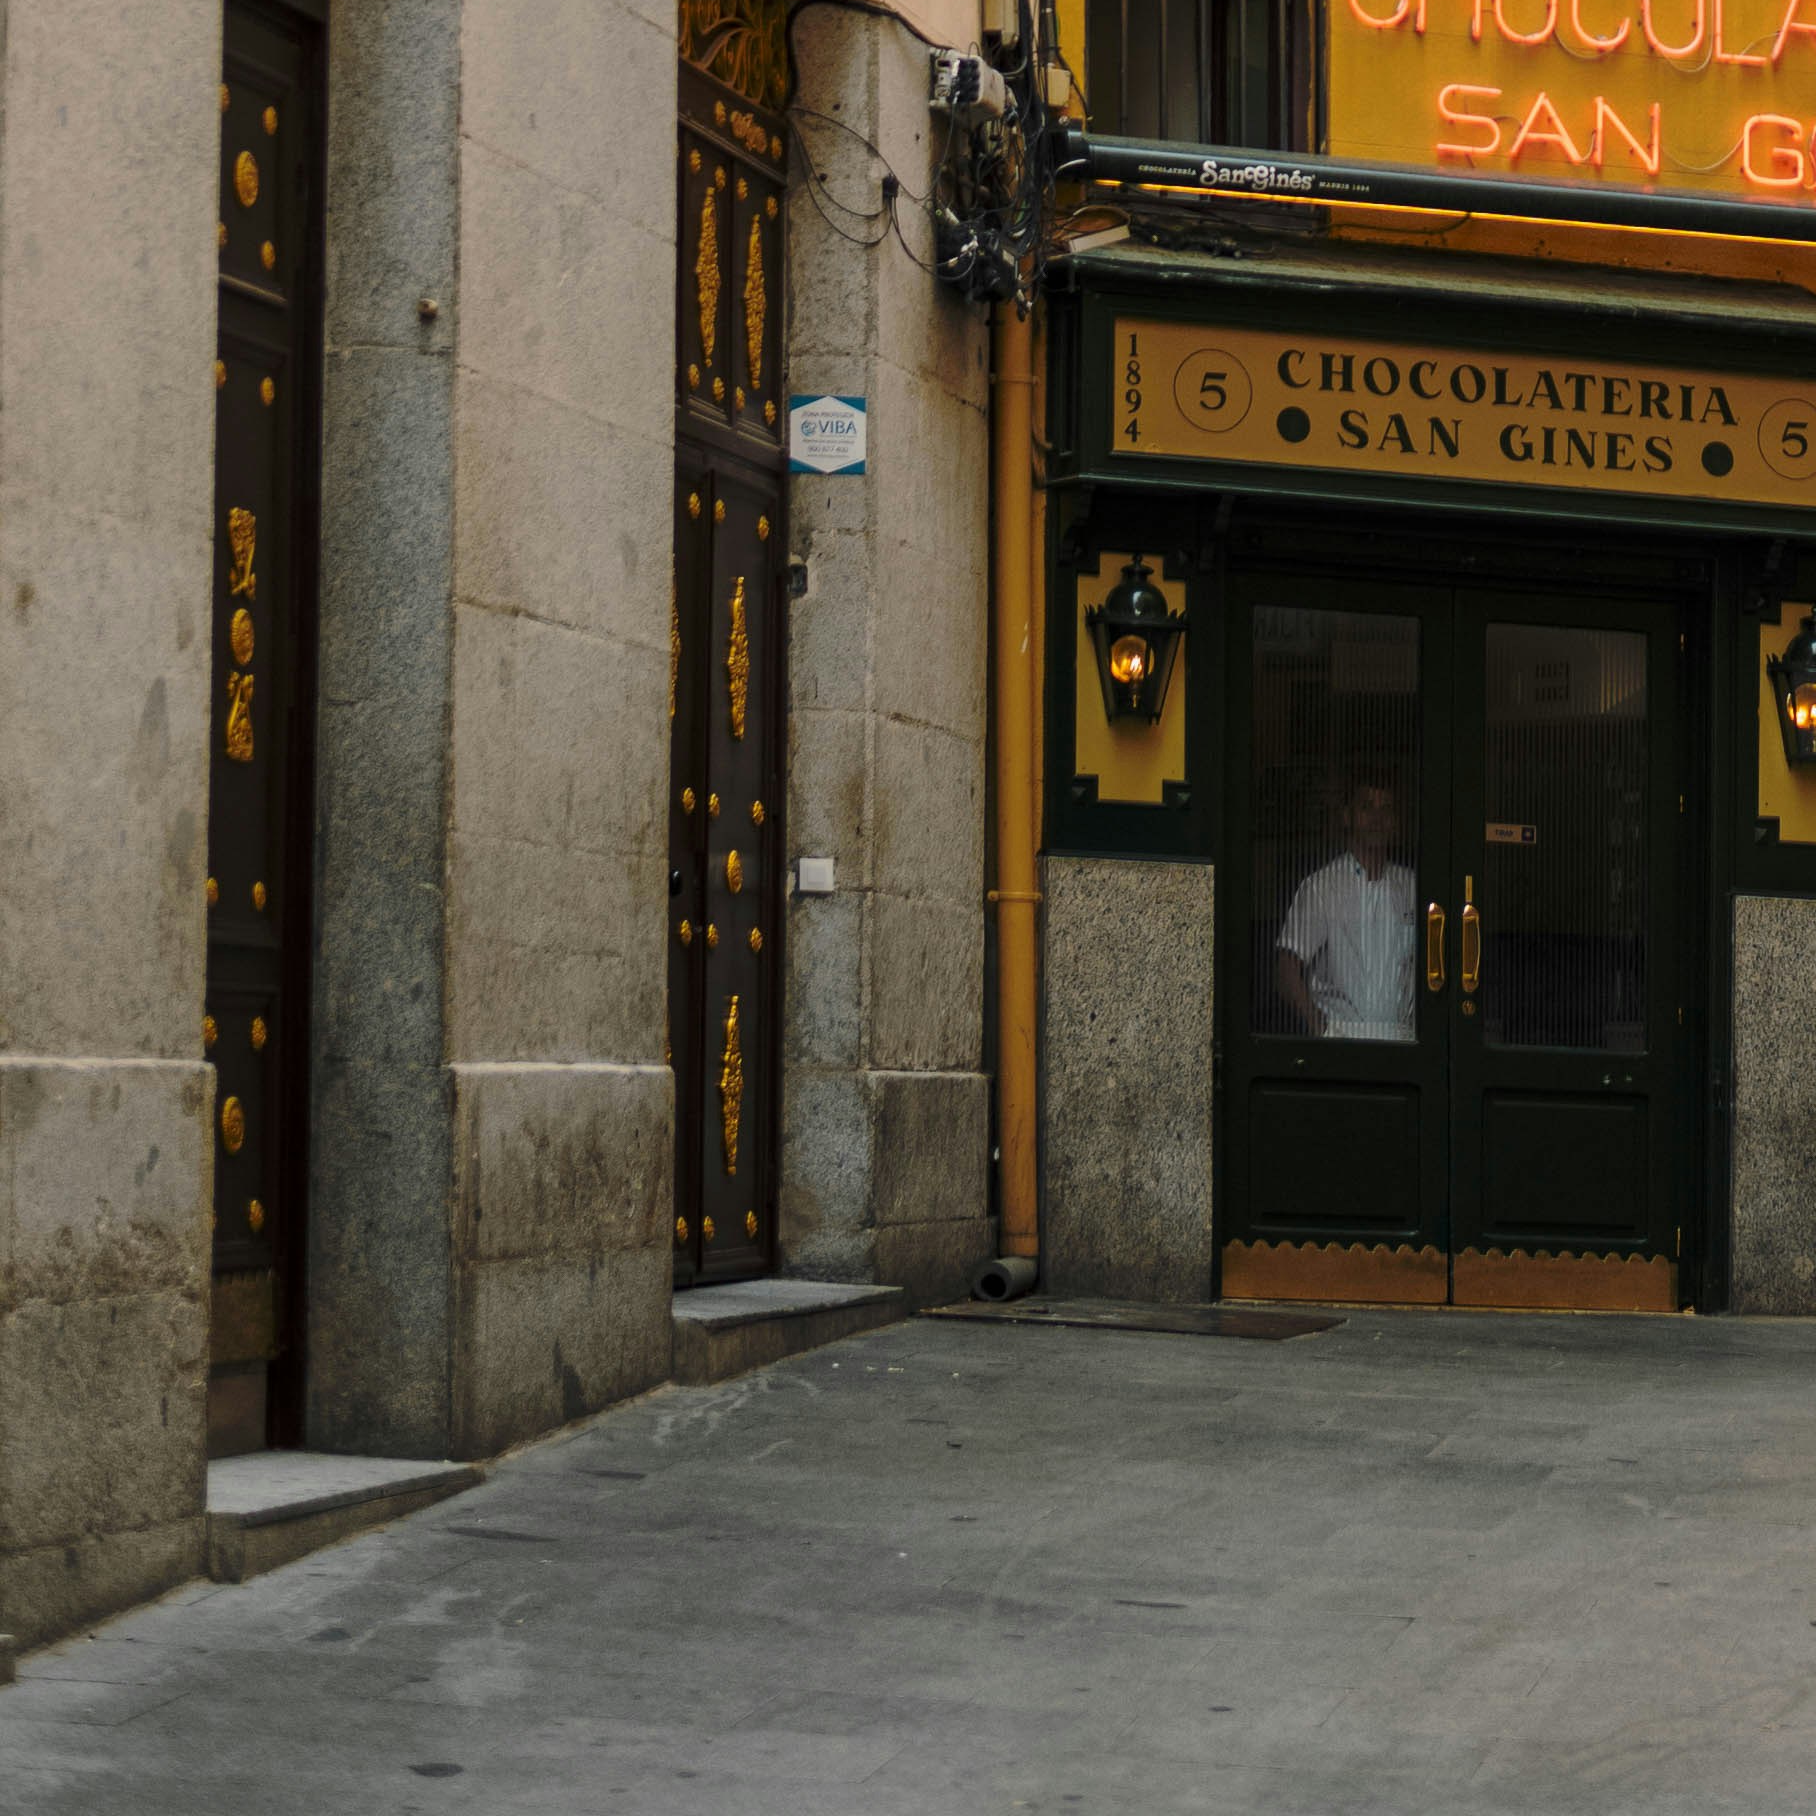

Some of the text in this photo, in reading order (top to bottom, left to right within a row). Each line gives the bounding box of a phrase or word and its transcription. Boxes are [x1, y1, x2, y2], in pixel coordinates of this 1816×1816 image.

[1435, 82, 1662, 174] SAN
[1124, 333, 1143, 443] 1894
[1199, 371, 1228, 410] 5
[1276, 348, 1739, 427] CHOCOLATERIA
[818, 419, 857, 434] VIBA
[1336, 409, 1674, 473] SAN GINES
[1781, 421, 1809, 459] 5
